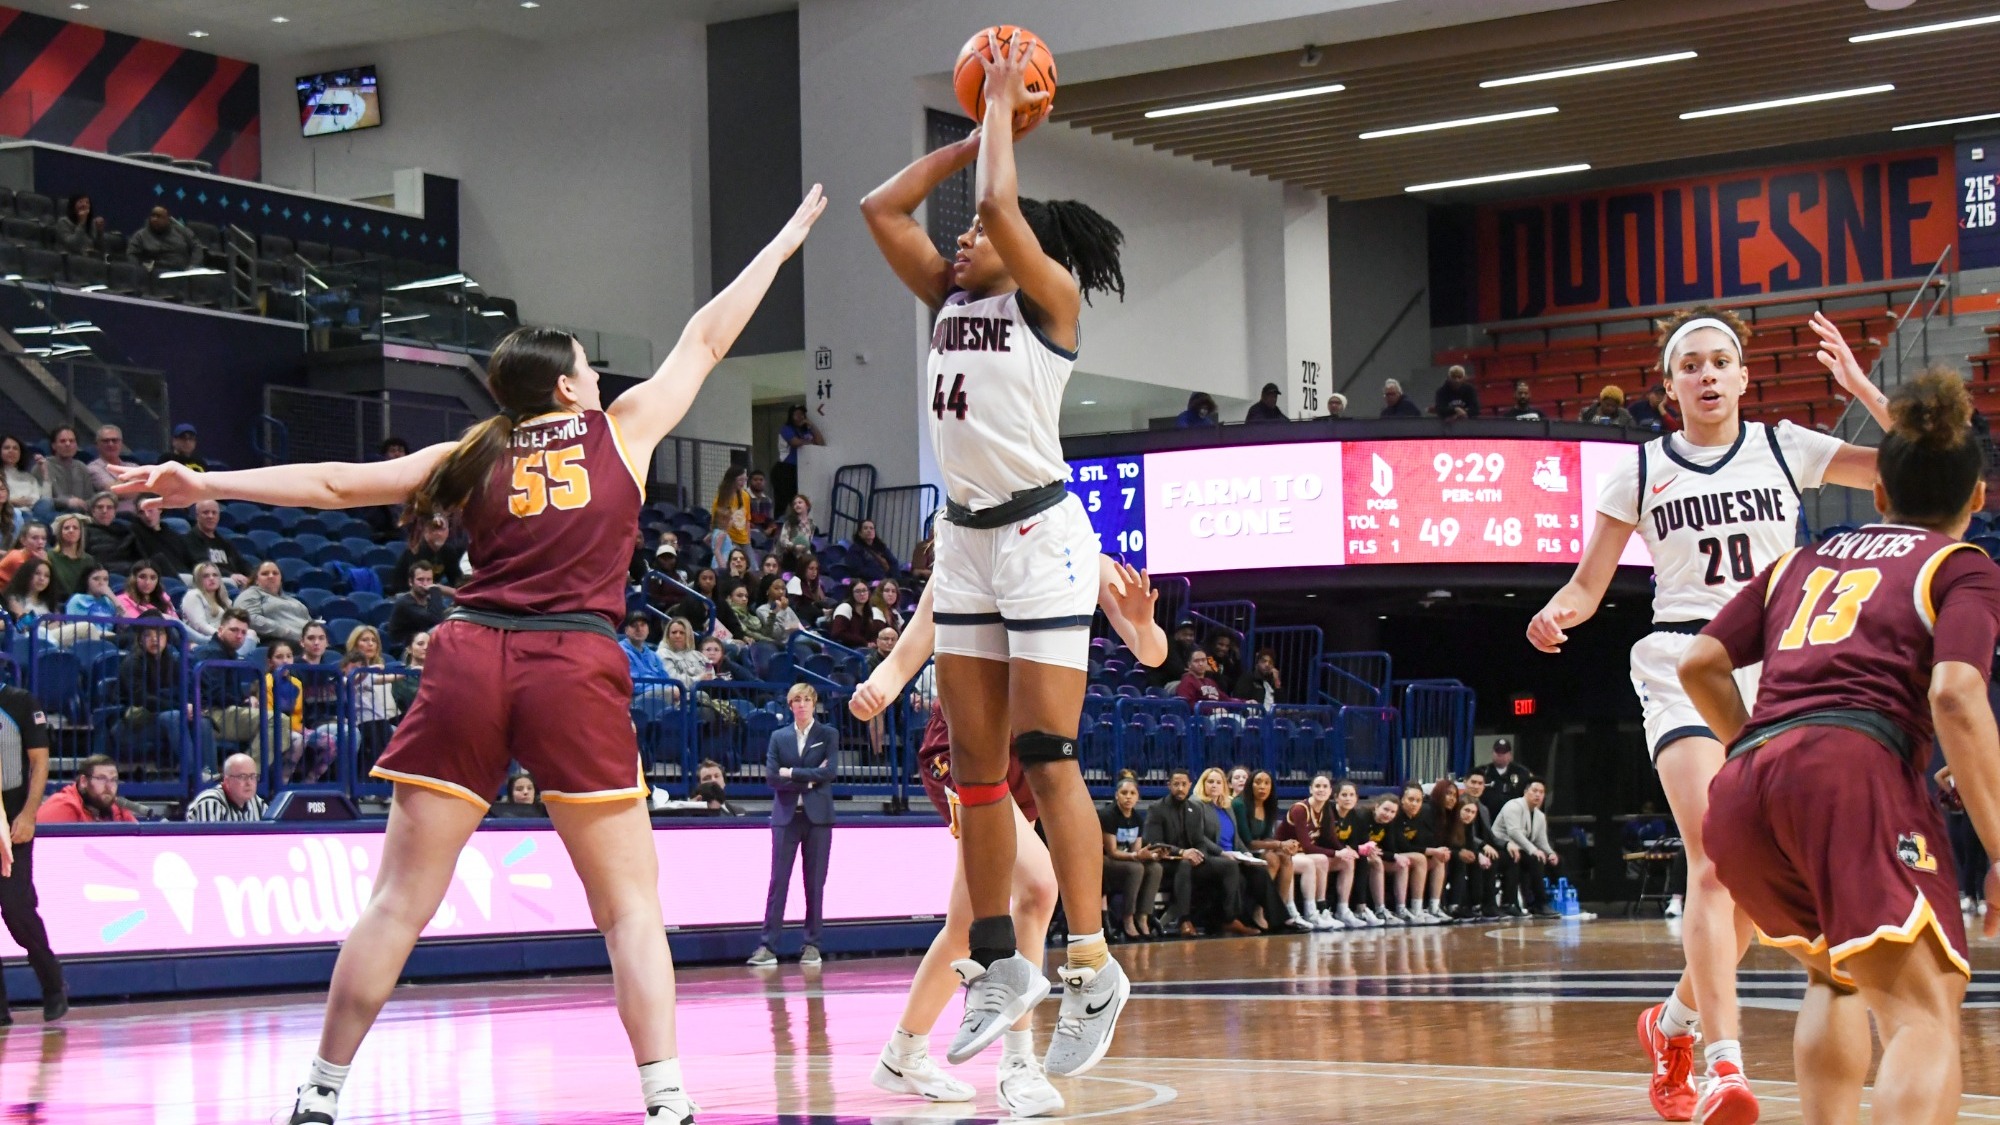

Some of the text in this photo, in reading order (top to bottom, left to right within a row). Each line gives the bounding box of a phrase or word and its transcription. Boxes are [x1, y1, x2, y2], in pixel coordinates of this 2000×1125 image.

[1964, 174, 1996, 202] 215
[1965, 201, 1997, 229] 216
[1500, 157, 1942, 319] DUQUESNE
[1302, 360, 1316, 385] 212
[932, 373, 968, 420] 44
[1303, 386, 1317, 411] 216
[508, 443, 592, 518] 55
[1080, 465, 1108, 482] STL
[1117, 462, 1140, 479] TO
[1433, 452, 1505, 483] 9:29
[1088, 487, 1136, 513] 5 7
[1161, 473, 1324, 509] FARM TO
[1366, 498, 1399, 511] POSS
[1475, 488, 1502, 503] 4TH
[1189, 507, 1294, 539] CONE
[1348, 514, 1400, 530] TOL 4
[1534, 513, 1579, 529] TOL 3
[1651, 488, 1786, 541] DUQUESNE
[1116, 529, 1144, 553] 10
[1419, 517, 1460, 547] 49
[1483, 516, 1523, 547] 48
[1349, 539, 1400, 554] FLS 1
[1537, 538, 1580, 554] FLS 0
[1698, 533, 1756, 587] 20
[1816, 532, 1927, 561] CHIVERS
[1778, 566, 1883, 651] 13
[1514, 699, 1533, 715] EXIT
[307, 801, 326, 814] POSS
